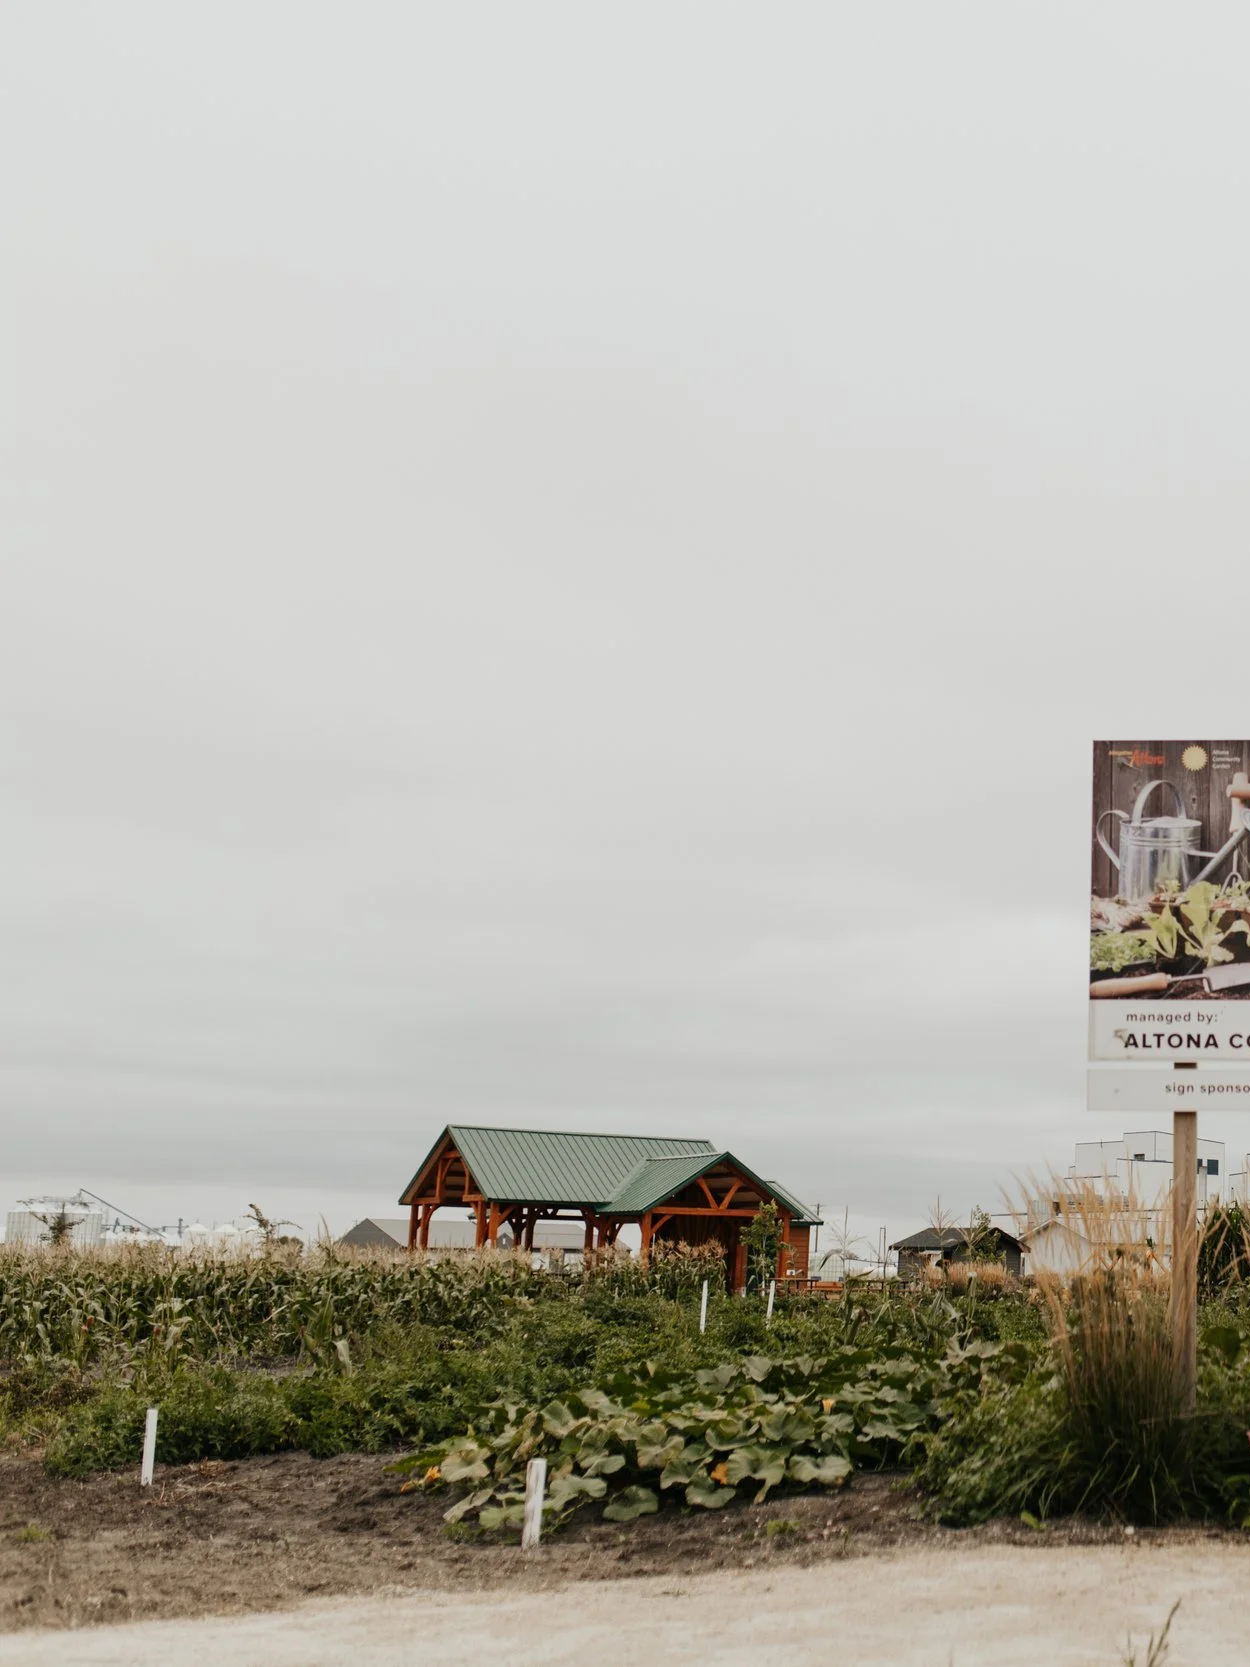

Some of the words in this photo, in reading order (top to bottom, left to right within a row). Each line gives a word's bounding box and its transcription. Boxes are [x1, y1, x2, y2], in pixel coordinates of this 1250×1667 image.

[1125, 1011, 1192, 1023] managed
[1196, 1011, 1219, 1023] by:
[1123, 1032, 1220, 1050] ALTONA
[1164, 1082, 1195, 1095] sign
